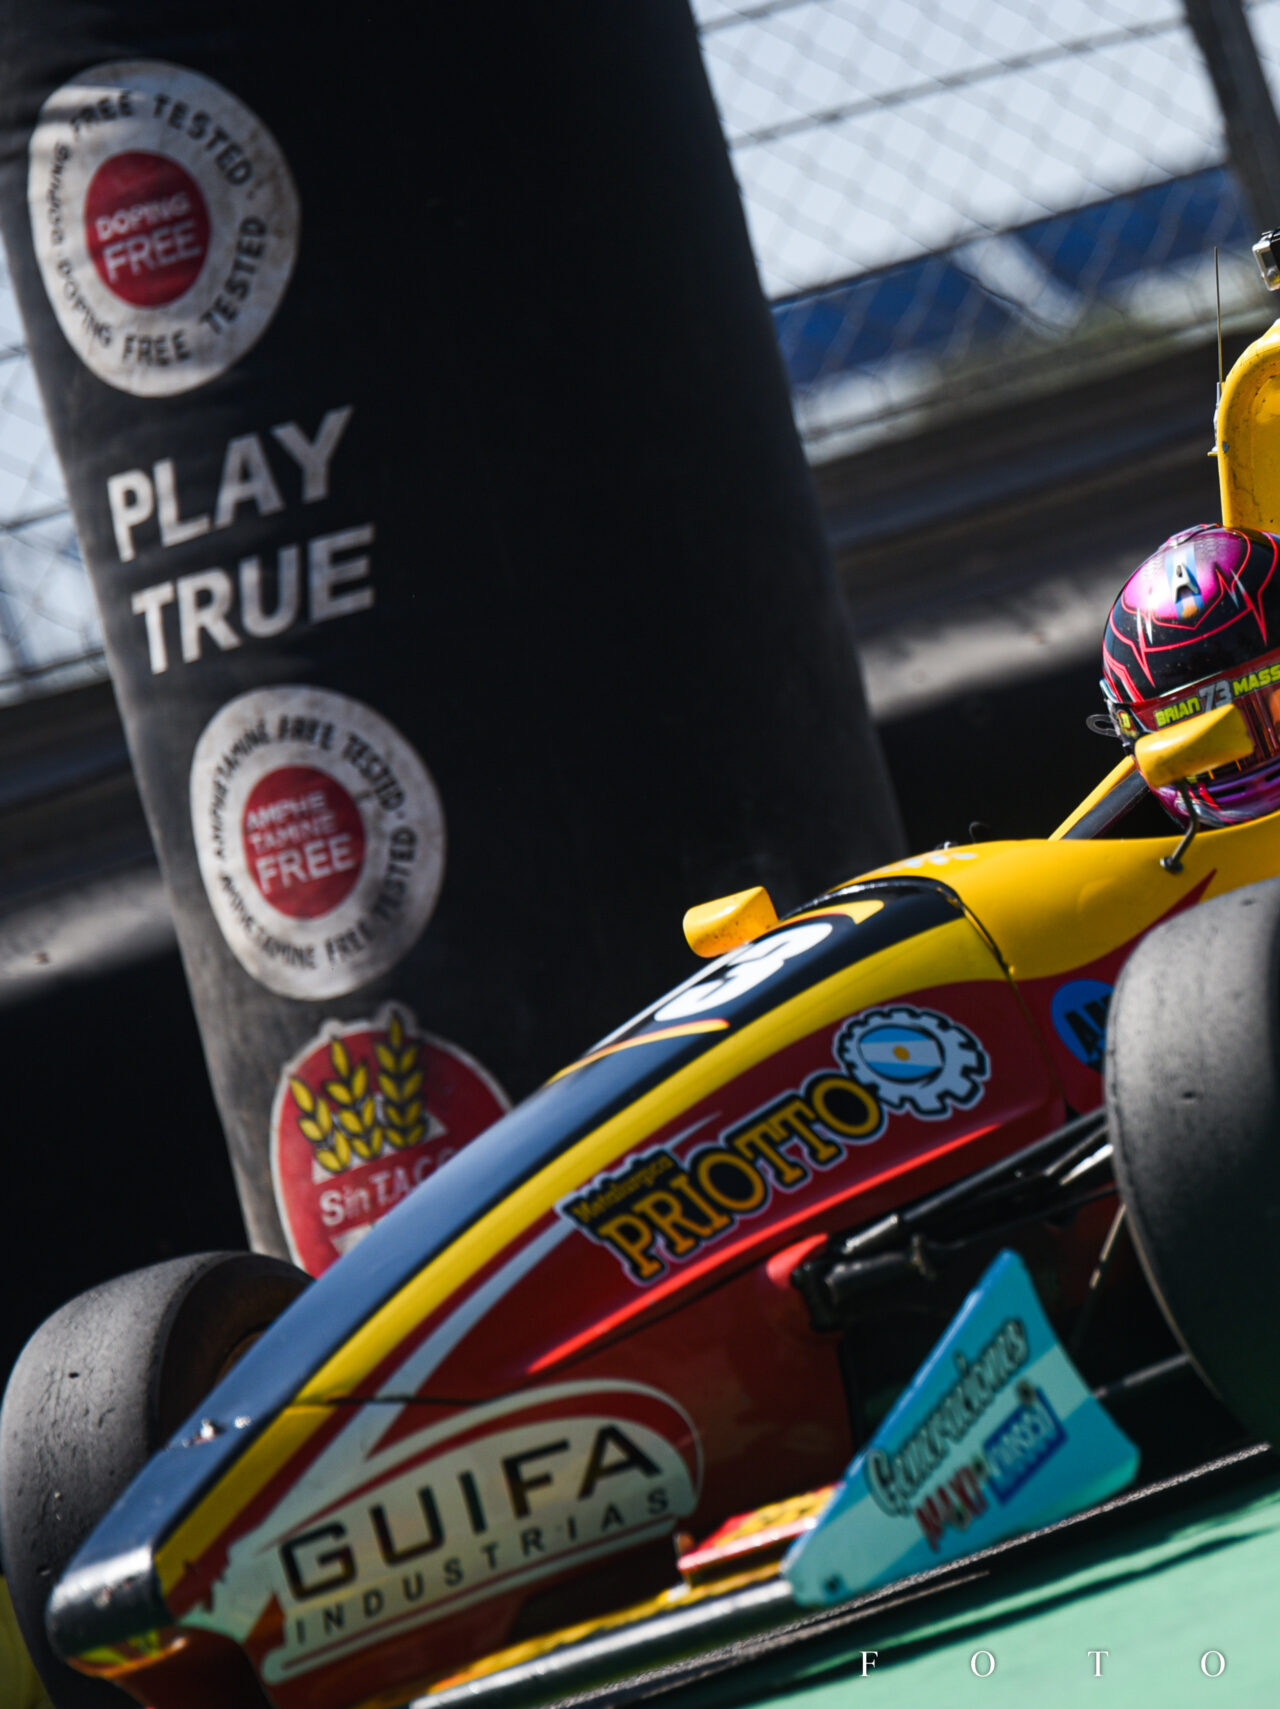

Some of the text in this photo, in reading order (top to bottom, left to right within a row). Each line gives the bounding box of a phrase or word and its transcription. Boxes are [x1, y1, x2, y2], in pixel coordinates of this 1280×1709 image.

[69, 90, 135, 134] FREE
[150, 93, 253, 187] TESTED
[95, 192, 192, 242] DOPING
[101, 219, 205, 285] FREE
[122, 329, 192, 368] FREE
[201, 215, 267, 336] TESTED
[107, 404, 353, 563] PLAY
[130, 523, 375, 675] TRUE
[1154, 697, 1201, 728] BRIAN
[1199, 679, 1233, 713] 73
[253, 833, 355, 896] FREE
[318, 1186, 372, 1227] Sin
[597, 1077, 881, 1279] PRIOTTO
[279, 1424, 663, 1601] GUIFA
[296, 1487, 670, 1644] INDUSTRIAS
